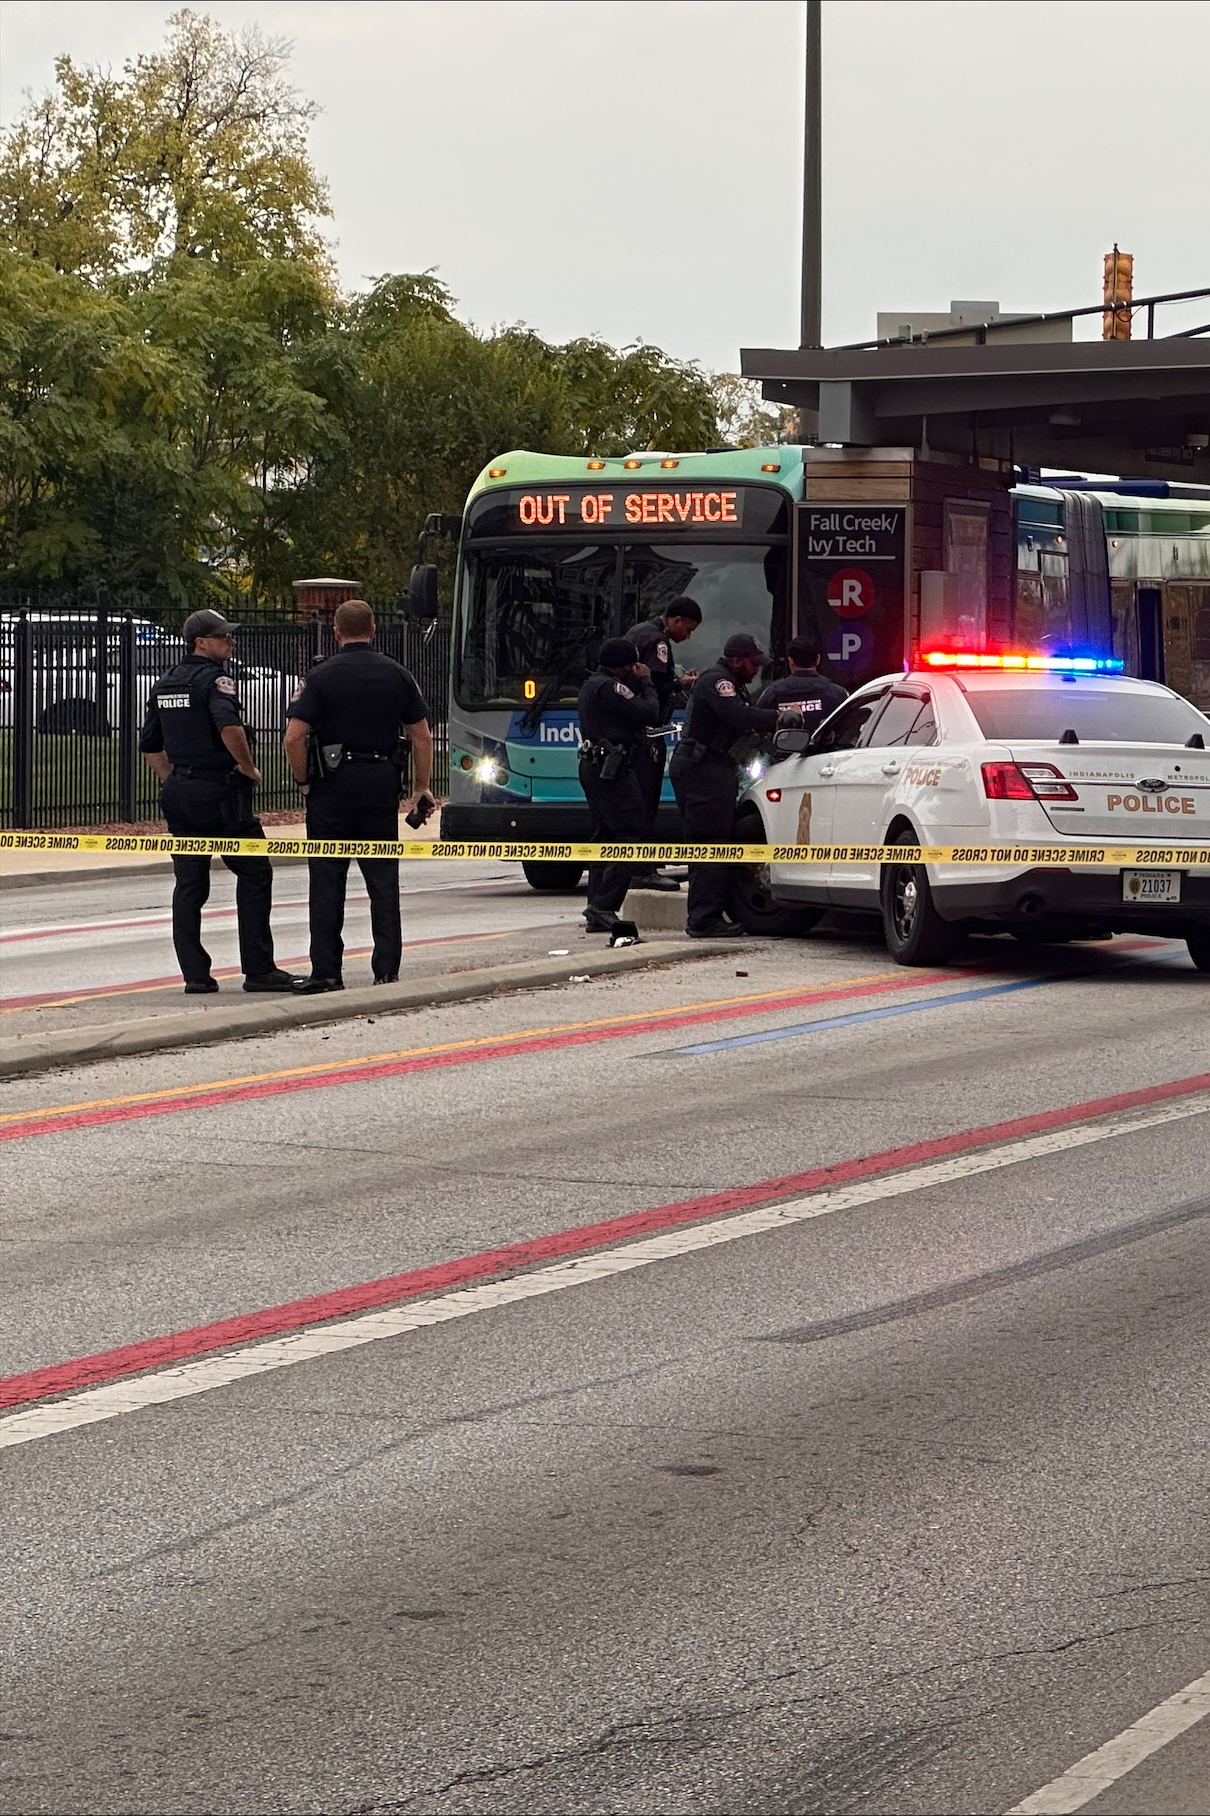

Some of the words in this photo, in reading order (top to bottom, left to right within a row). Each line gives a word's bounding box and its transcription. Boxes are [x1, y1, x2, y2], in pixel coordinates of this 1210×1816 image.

[519, 494, 570, 525] OUT
[580, 494, 614, 524] OF
[624, 491, 738, 523] SERVICE
[810, 513, 840, 531] Fall
[843, 513, 898, 534] Creek/
[808, 535, 832, 556] Ivy
[835, 535, 876, 552] Tech
[157, 699, 191, 709] POLICE
[905, 768, 941, 786] POLICE
[1069, 771, 1135, 779] INDIANAPOLIS
[1107, 795, 1196, 814] POLICE
[1142, 879, 1171, 893] 21037
